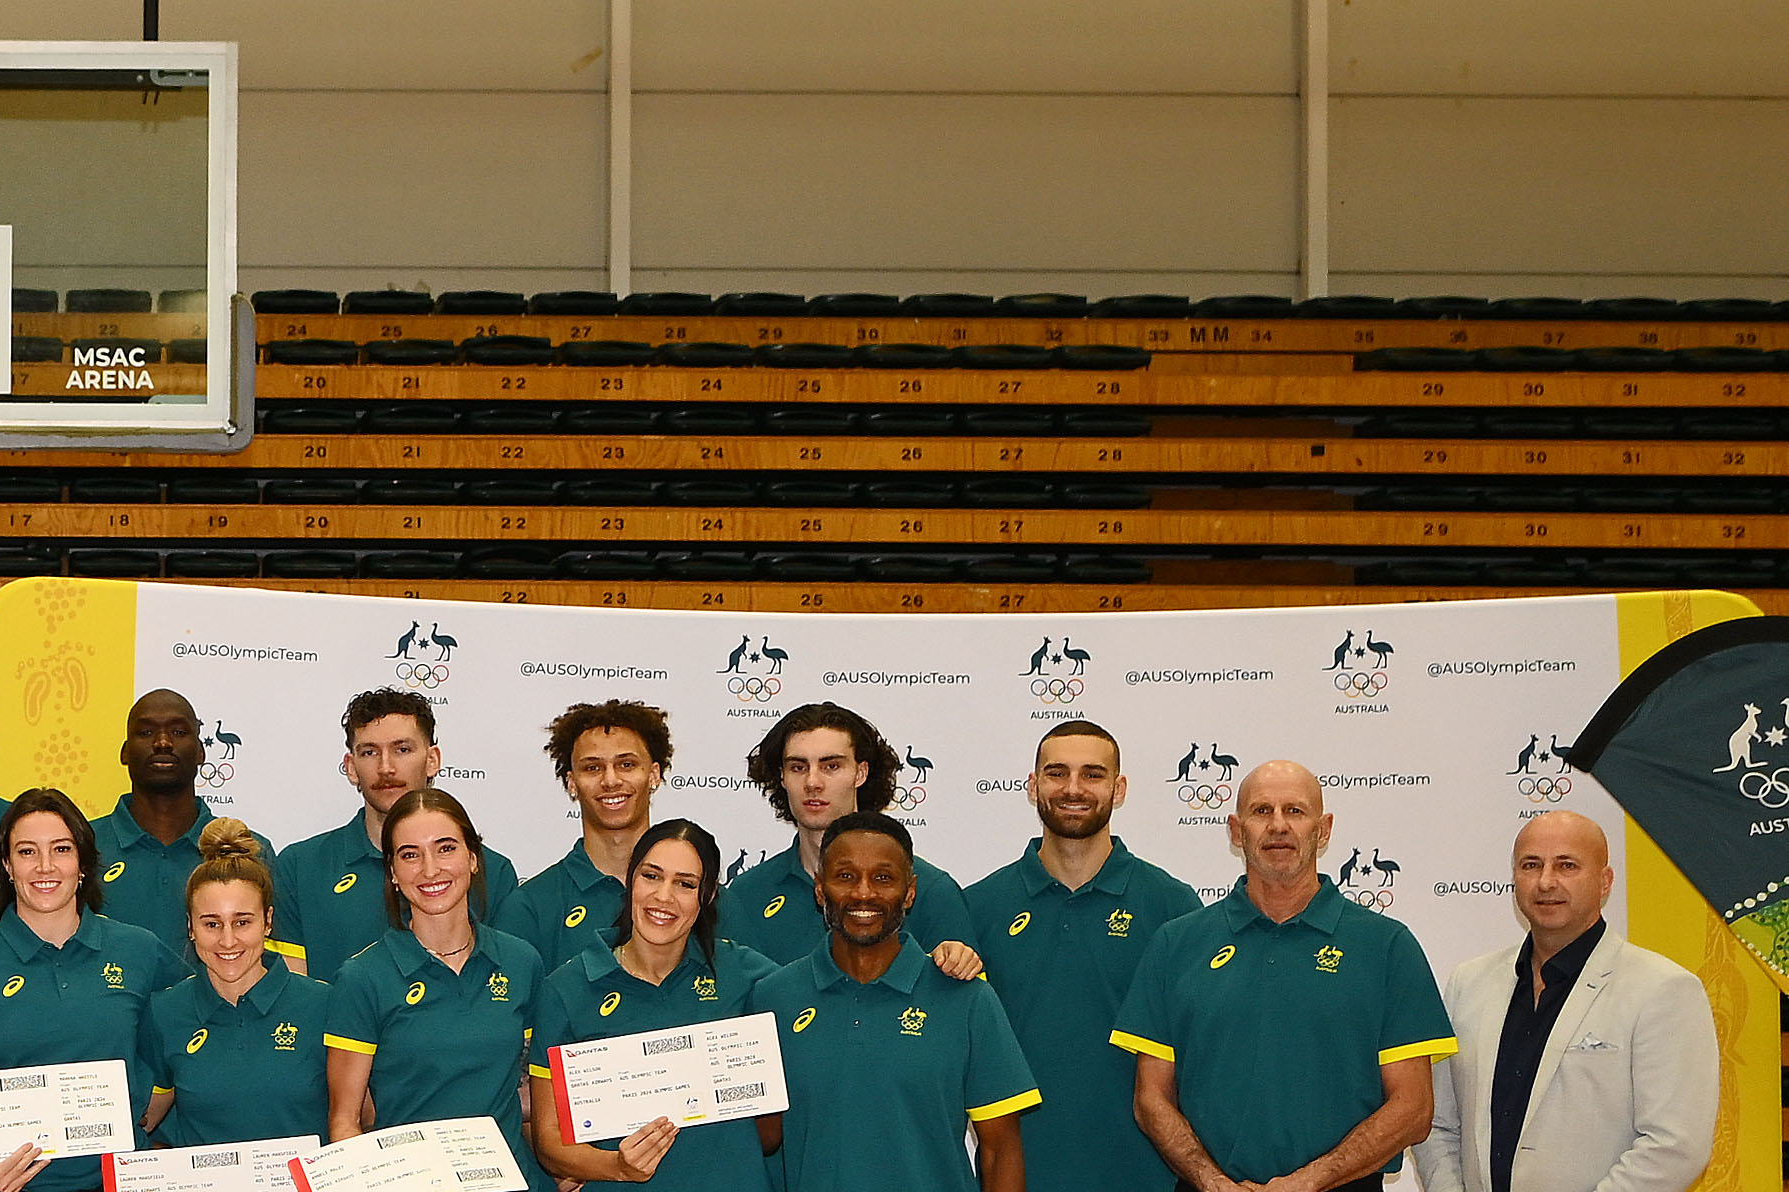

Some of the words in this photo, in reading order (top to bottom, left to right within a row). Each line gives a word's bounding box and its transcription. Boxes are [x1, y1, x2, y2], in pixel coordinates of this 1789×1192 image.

[287, 325, 308, 337] 24
[380, 325, 403, 338] 25
[570, 326, 592, 338] 27
[665, 327, 686, 339] 28
[758, 327, 783, 340] 29
[74, 347, 146, 368] MSAC
[65, 369, 155, 390] ARENA
[303, 375, 327, 390] 20
[402, 376, 420, 390] 21
[501, 377, 526, 390] 22
[601, 378, 624, 391] 23
[701, 378, 723, 391] 24
[798, 380, 821, 393] 25
[900, 380, 922, 393] 26
[999, 381, 1022, 394] 27
[1097, 382, 1121, 395] 28
[1423, 382, 1444, 396] 29
[1523, 382, 1546, 397] 30
[1623, 383, 1638, 397] 31
[1723, 383, 1746, 397] 32
[305, 445, 327, 458] 20
[402, 445, 421, 458] 21
[501, 446, 524, 459] 22
[602, 446, 625, 459] 23
[701, 447, 724, 460] 24
[800, 447, 822, 460] 25
[901, 447, 923, 461] 26
[1000, 447, 1024, 461] 27
[1098, 449, 1122, 461] 28
[1424, 450, 1448, 463] 29
[1525, 451, 1547, 464] 30
[1622, 450, 1640, 465] 31
[1723, 452, 1745, 465] 32
[10, 514, 32, 527] 17
[110, 514, 130, 527] 18
[209, 515, 228, 528] 19
[305, 516, 329, 529] 20
[403, 516, 421, 529] 21
[501, 516, 526, 530] 22
[601, 518, 624, 531] 23
[702, 518, 723, 531] 24
[800, 519, 822, 532] 25
[900, 520, 923, 534] 26
[999, 520, 1024, 533] 27
[1098, 521, 1123, 533] 28
[1423, 522, 1449, 536] 29
[1525, 524, 1548, 537] 30
[1624, 524, 1641, 537] 31
[1722, 525, 1746, 539] 32
[603, 591, 627, 605] 23
[702, 592, 724, 605] 24
[801, 593, 823, 606] 25
[172, 642, 318, 662] @AUSOlympicTeam
[520, 662, 668, 680] @AUSOlympicTeam
[1427, 659, 1576, 676] @AUSOlympicTeam
[822, 671, 970, 687] @AUSOlympicTeam
[1125, 668, 1274, 686] @AUSOlympicTeam
[726, 708, 783, 718] AUSTRALIA
[1030, 710, 1086, 720] AUSTRALIA
[1334, 704, 1389, 714] AUSTRALIA
[575, 1046, 608, 1056] QANTAS
